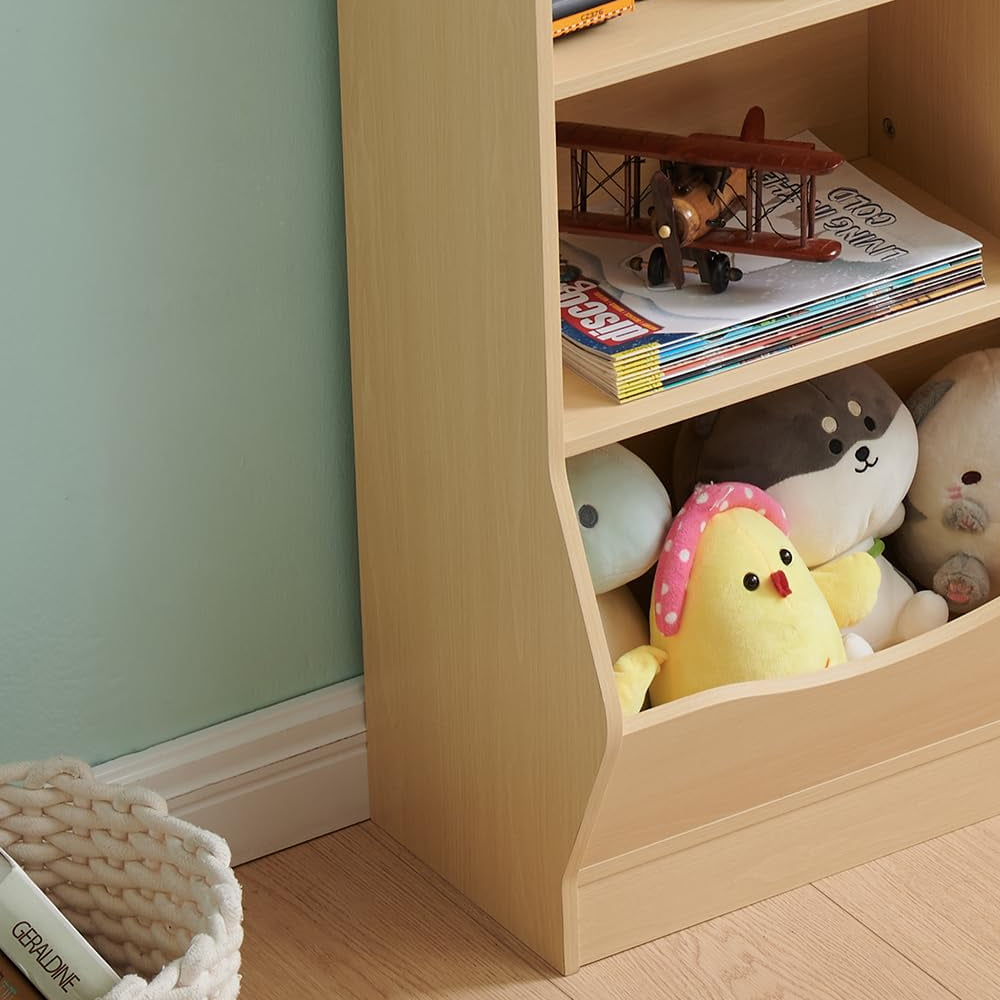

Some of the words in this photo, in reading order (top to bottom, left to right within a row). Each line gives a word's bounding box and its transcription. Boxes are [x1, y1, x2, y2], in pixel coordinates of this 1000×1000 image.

[827, 187, 897, 227] COLD
[823, 216, 909, 262] LIVING
[12, 920, 81, 993] GERALDINE
